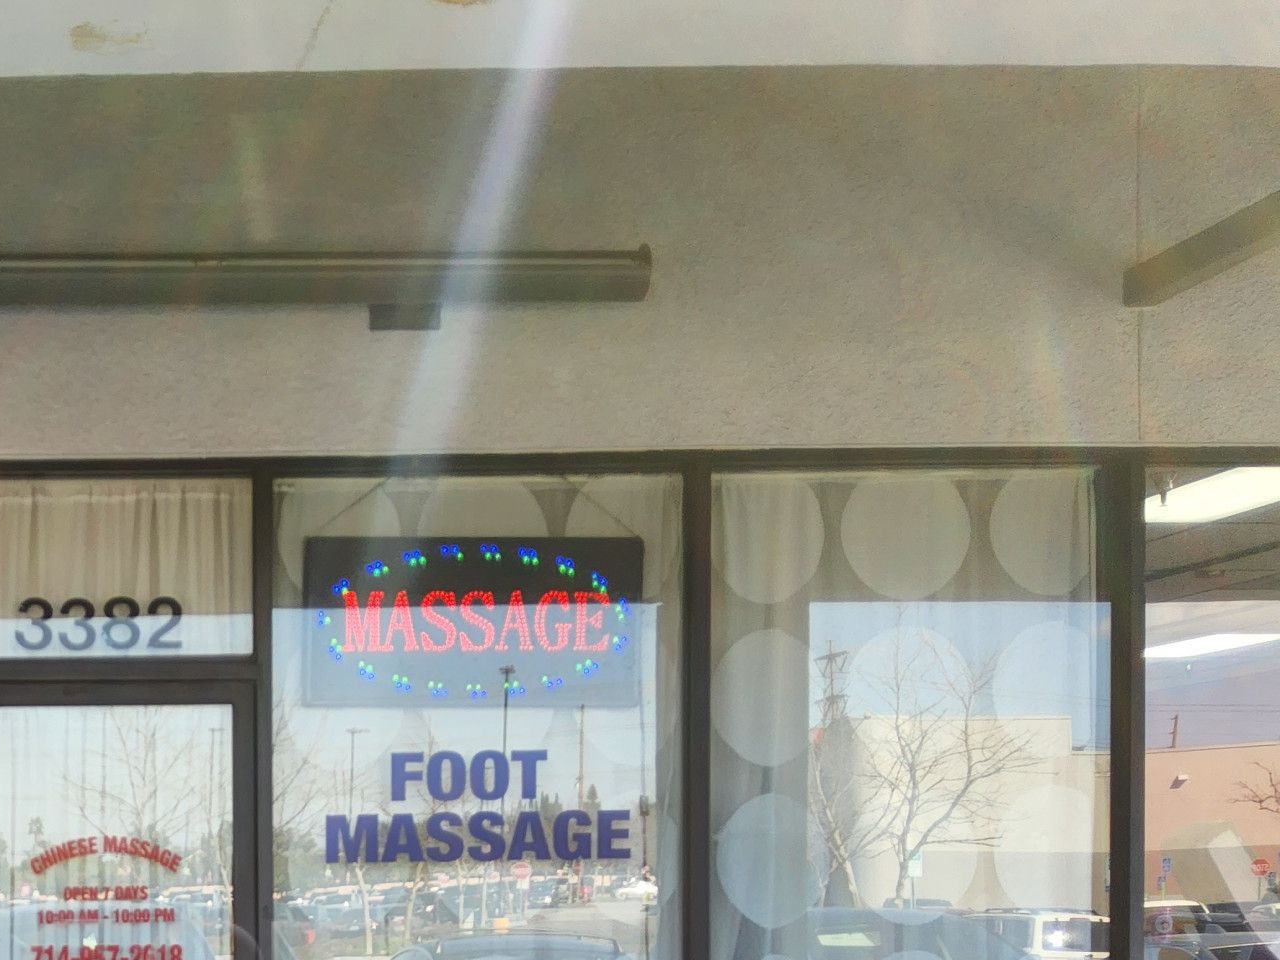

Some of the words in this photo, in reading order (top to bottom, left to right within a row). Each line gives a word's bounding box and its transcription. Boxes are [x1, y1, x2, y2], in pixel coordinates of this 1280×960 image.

[14, 596, 183, 651] 3382
[342, 590, 610, 653] MASSAGE
[390, 749, 548, 802] FOOT
[30, 836, 98, 875] CHINESE
[103, 834, 183, 873] MASSAGE
[325, 810, 631, 864] MASSAGE
[37, 910, 74, 924] 10:00
[79, 909, 99, 922] AM
[113, 908, 150, 923] 10:00
[154, 908, 176, 922] PM
[64, 886, 98, 901] OPEN
[103, 886, 111, 900] 7
[115, 886, 149, 901] DAYS
